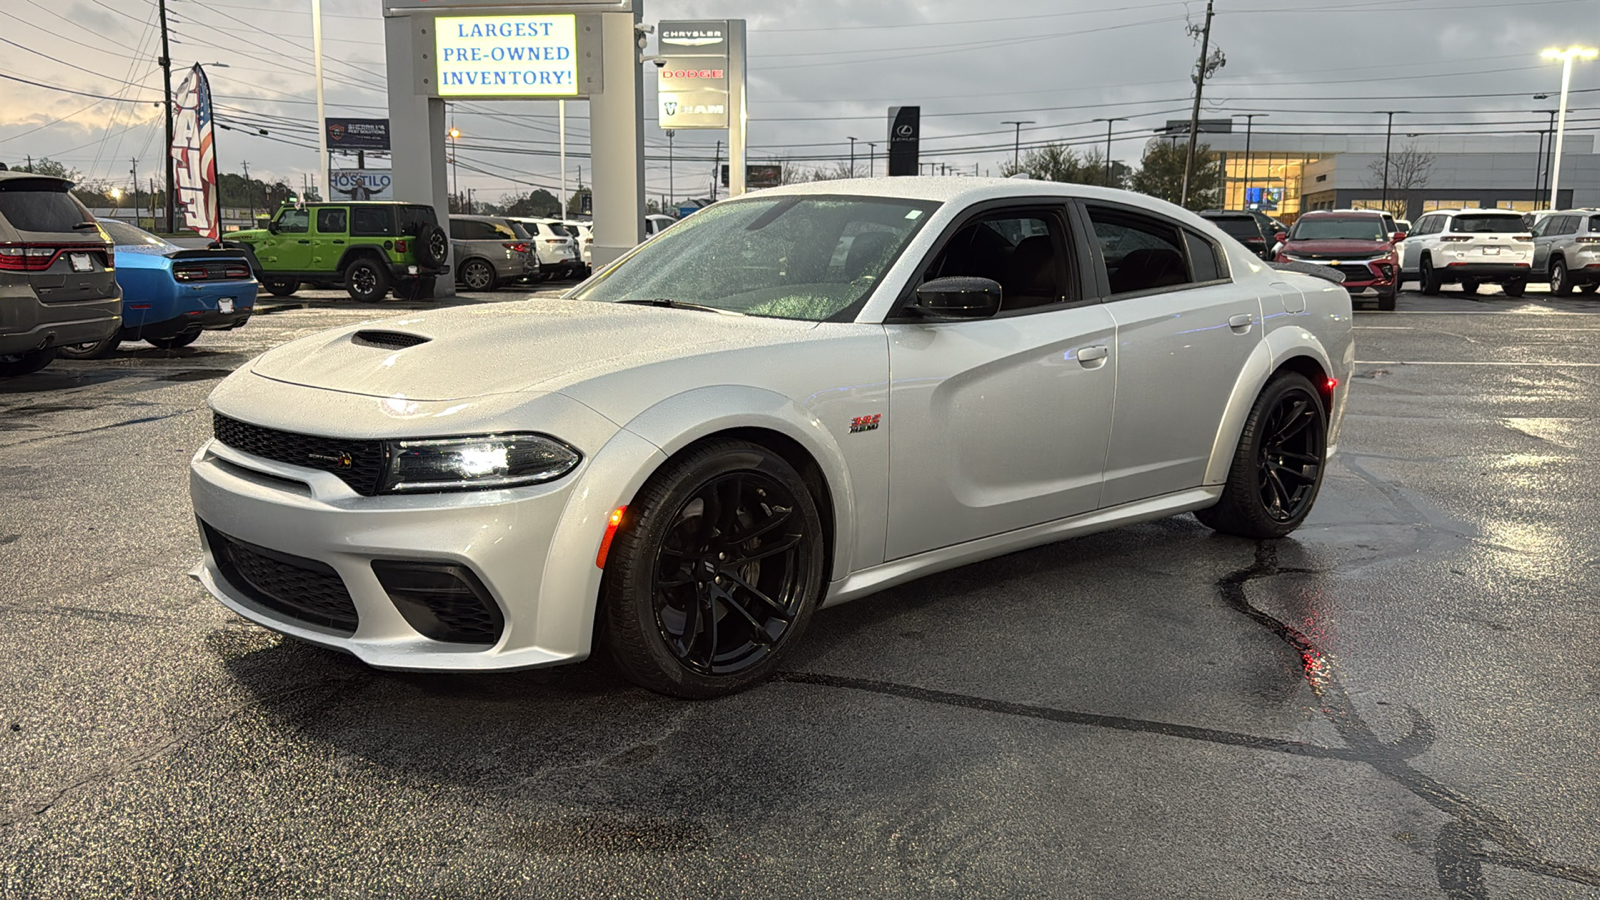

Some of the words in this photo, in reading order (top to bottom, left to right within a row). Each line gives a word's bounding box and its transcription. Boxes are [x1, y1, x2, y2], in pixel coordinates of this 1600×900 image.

[458, 22, 553, 38] LARGEST
[662, 30, 722, 38] CHRYSLER
[443, 46, 571, 62] PRE-OWNED
[443, 70, 572, 85] INVENTORY!
[662, 69, 724, 79] DODGE
[680, 104, 724, 114] RAM
[850, 413, 882, 427] 392
